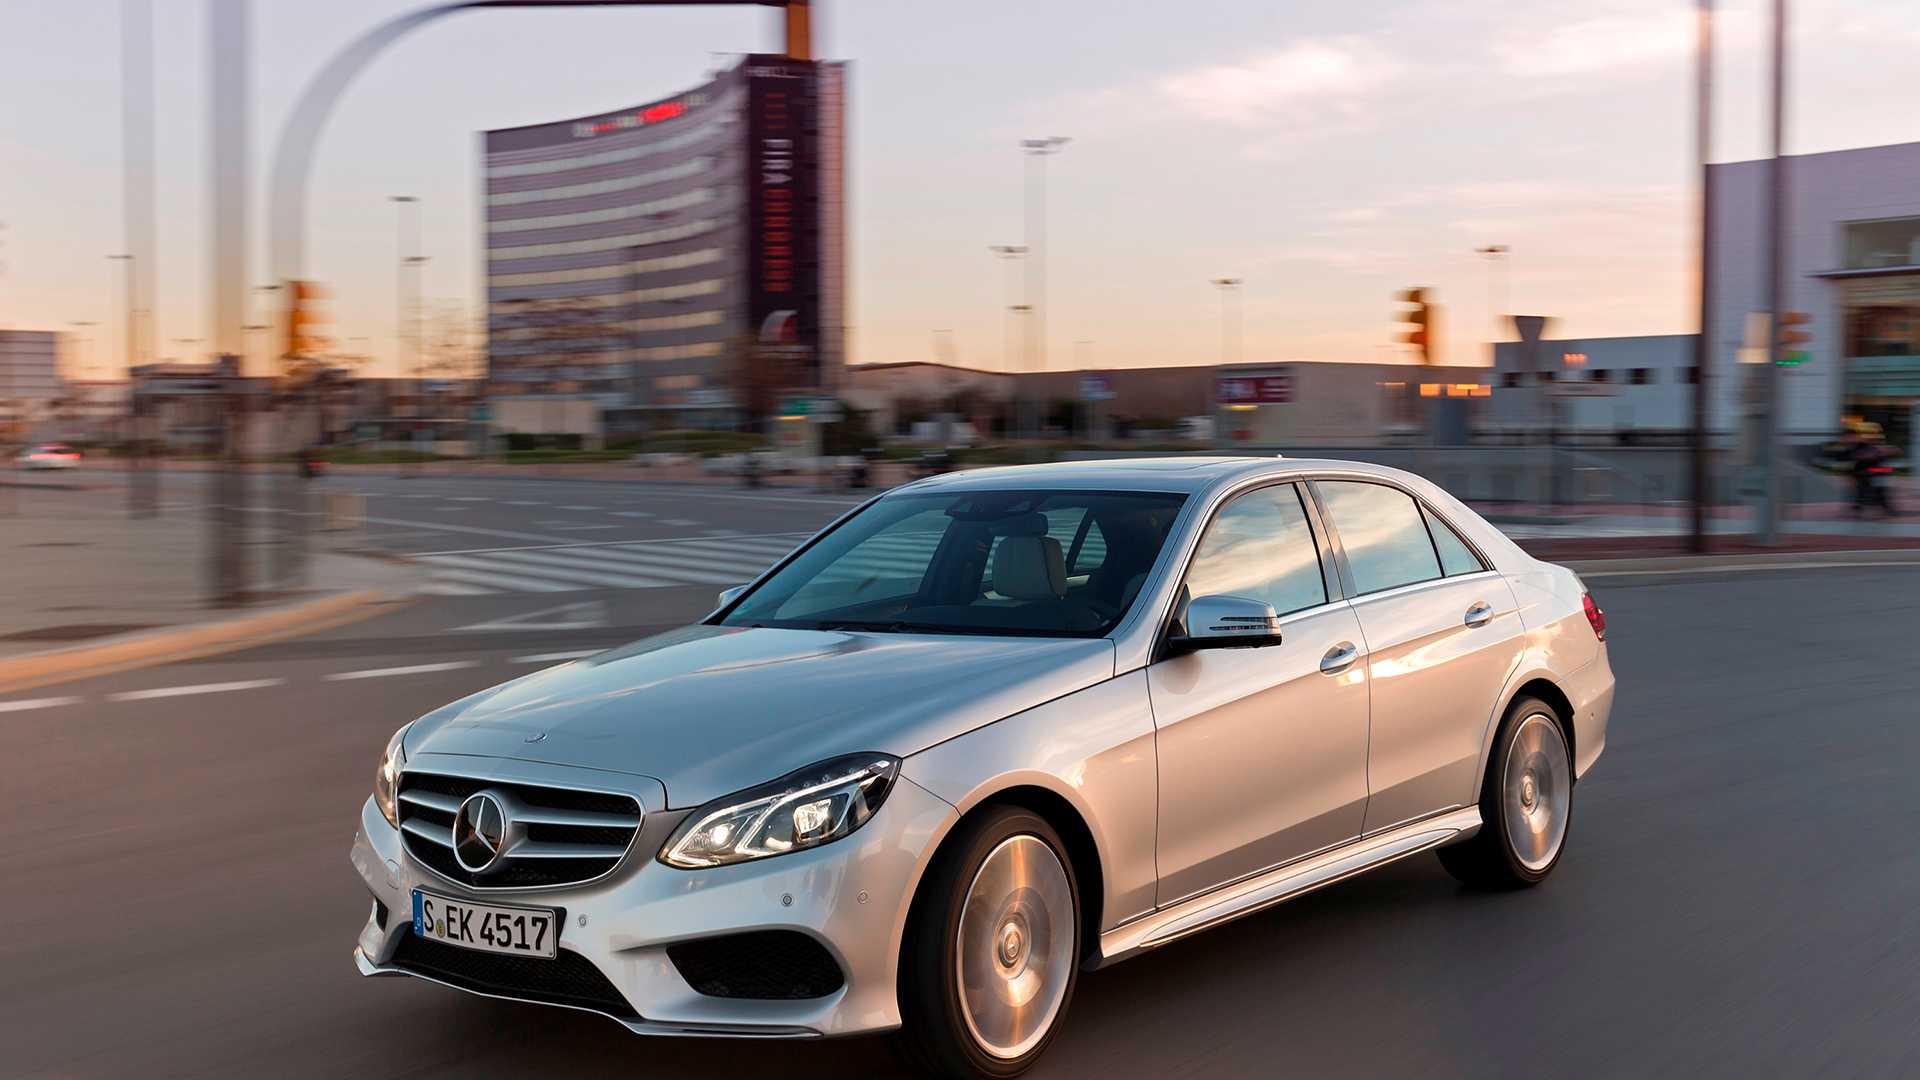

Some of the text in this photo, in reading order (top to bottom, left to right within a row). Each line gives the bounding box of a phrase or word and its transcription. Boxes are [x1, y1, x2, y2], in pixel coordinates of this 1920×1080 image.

[424, 900, 548, 951] S EK 4517
